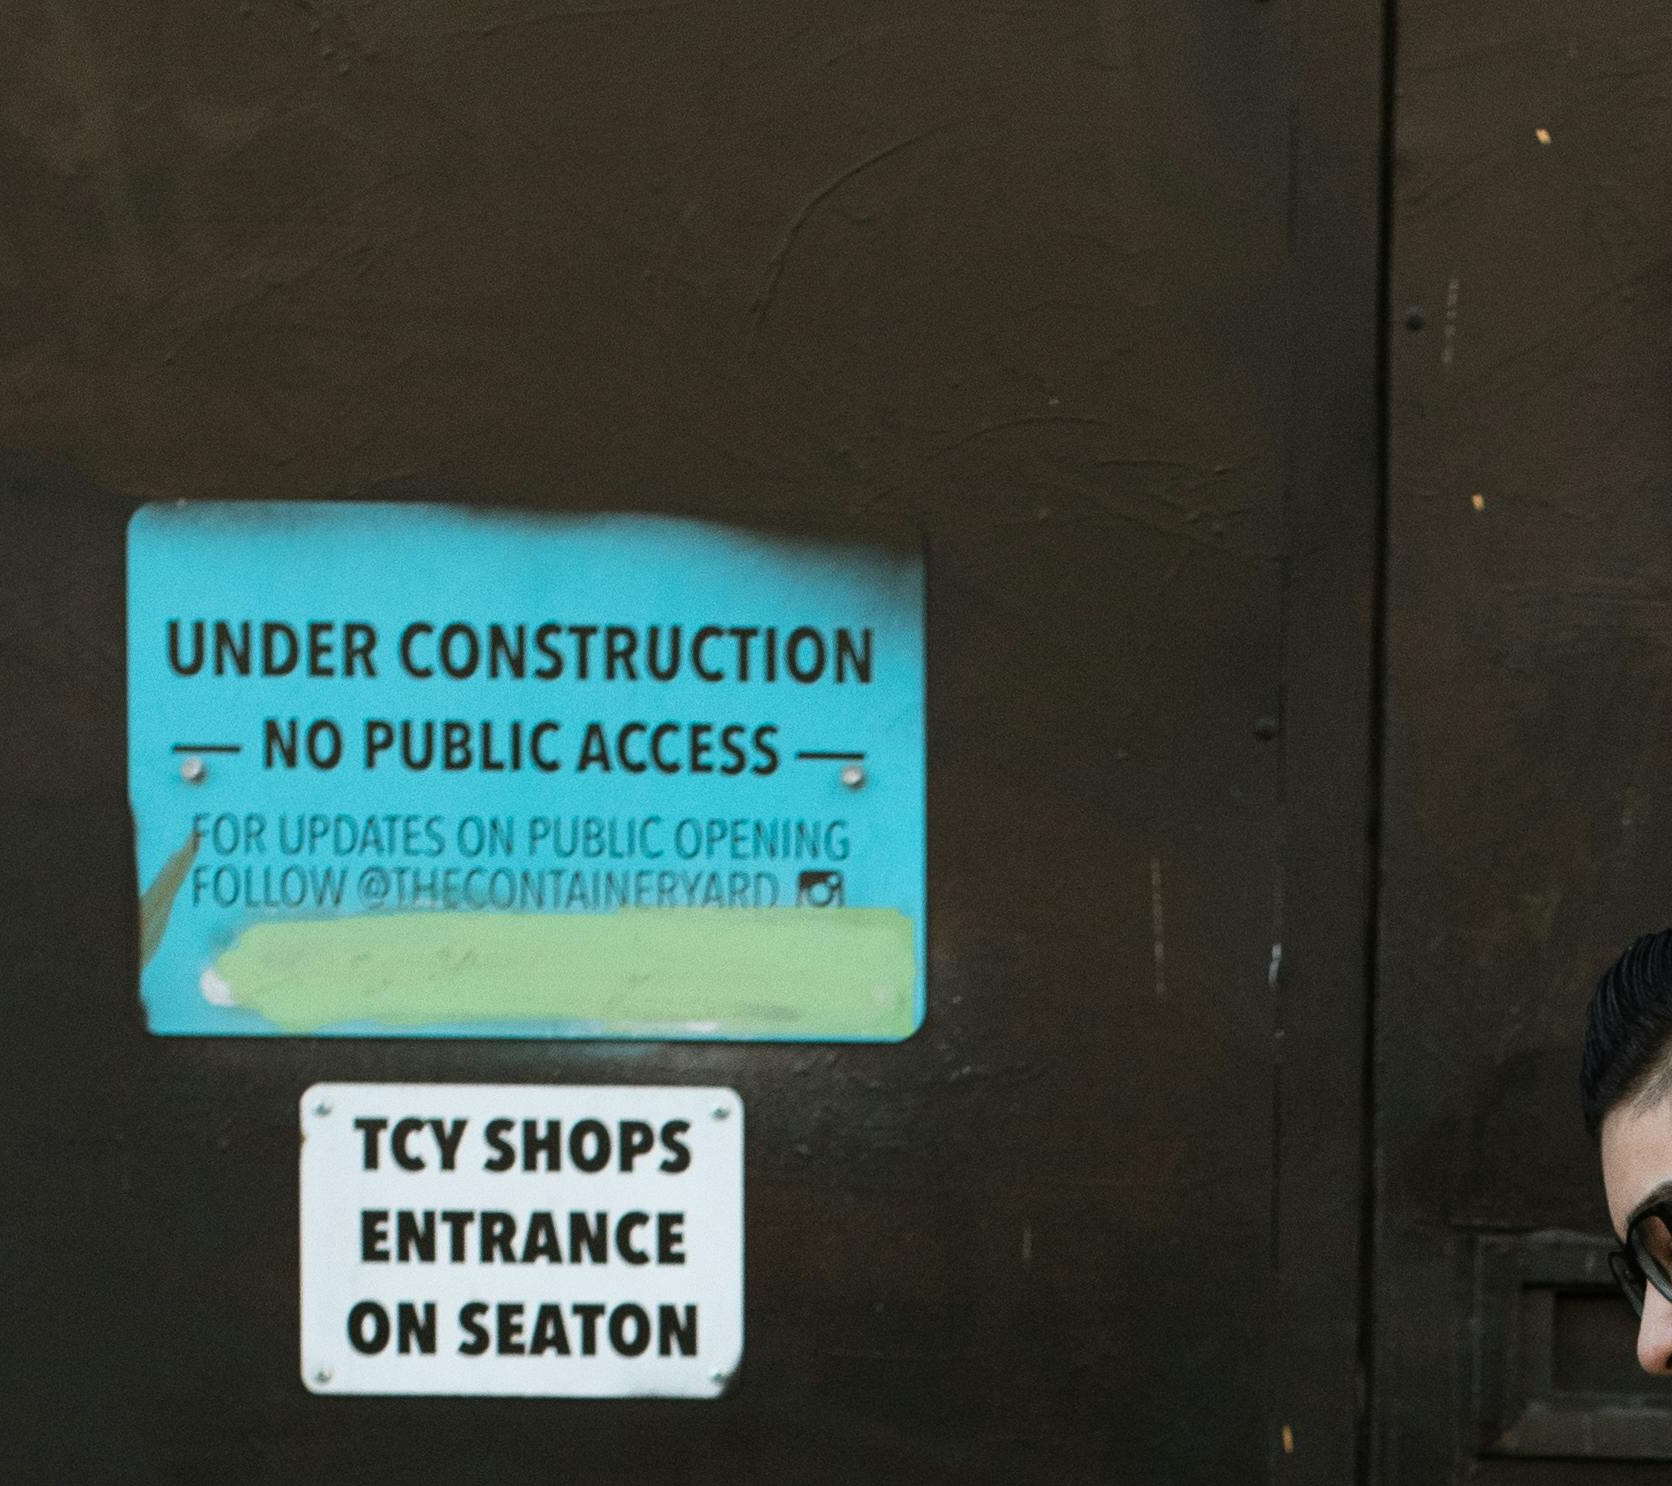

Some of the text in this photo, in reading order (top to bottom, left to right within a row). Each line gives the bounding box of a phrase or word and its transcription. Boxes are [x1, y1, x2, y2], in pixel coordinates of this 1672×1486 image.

[167, 619, 875, 685] UNDER CONSTRUCTION
[263, 718, 779, 776] NO PUBLIC ACCESS
[191, 813, 850, 862] FOR UPDATES ON PUBLIC OPENING
[192, 864, 779, 911] FOLLOW @THECONTAINERYARD
[353, 1116, 691, 1174] TCY SHOPS
[360, 1209, 686, 1266] ENTRANCE
[346, 1300, 698, 1358] ON SEATON
